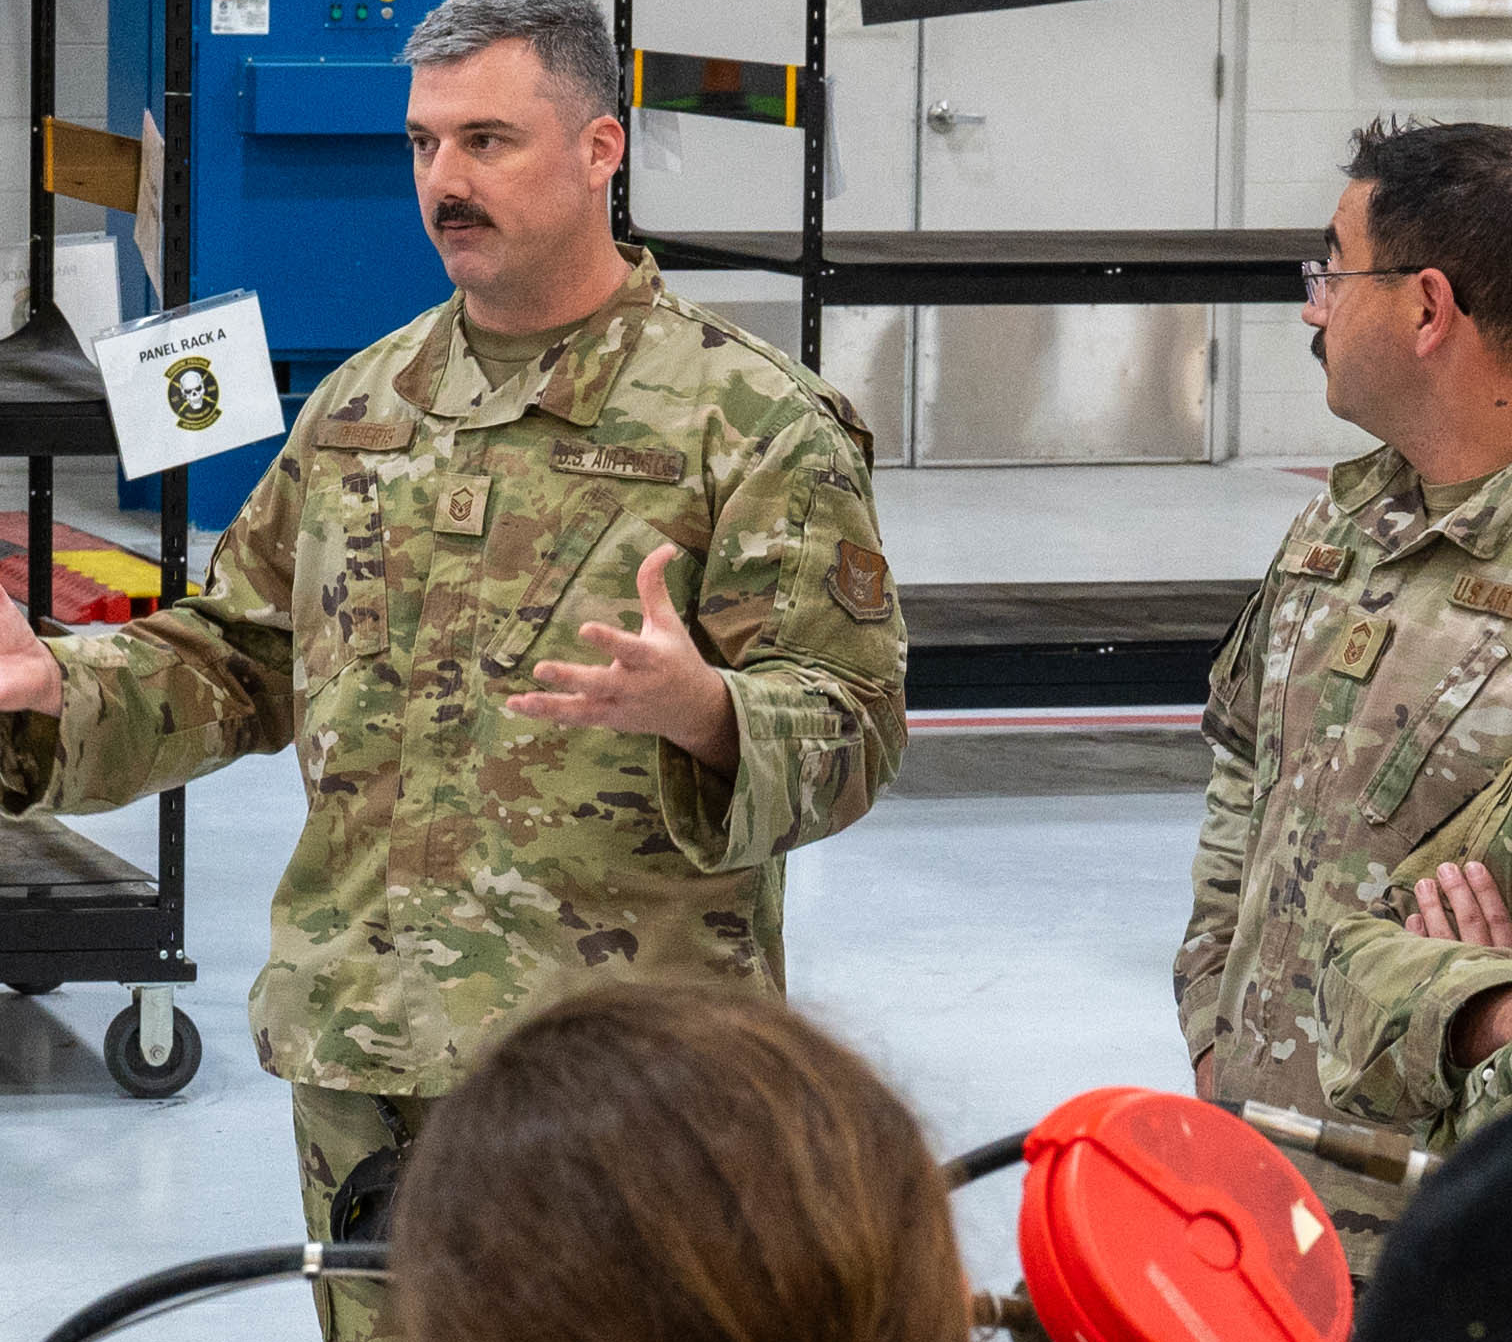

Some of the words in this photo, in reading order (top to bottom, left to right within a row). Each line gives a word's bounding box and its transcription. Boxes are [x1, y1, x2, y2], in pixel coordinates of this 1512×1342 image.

[139, 343, 178, 363] PANEL
[180, 331, 214, 351] RACK
[218, 328, 227, 340] A
[591, 446, 617, 470] AIR
[617, 449, 678, 477] FORCE
[1484, 583, 1510, 611] AIR
